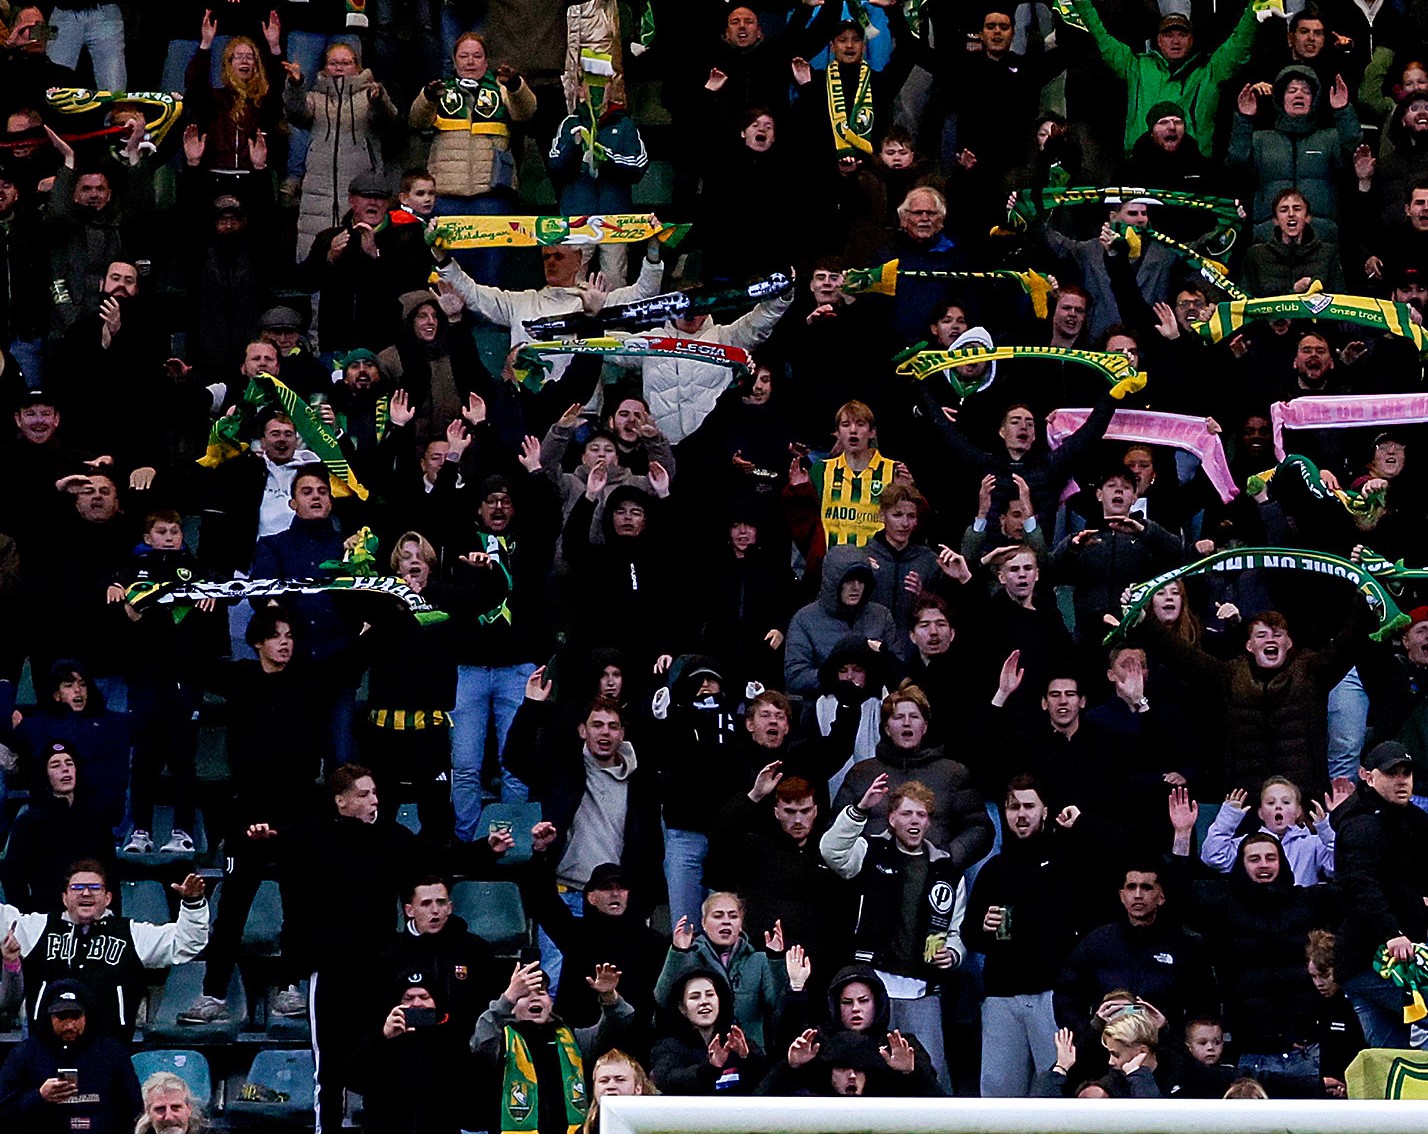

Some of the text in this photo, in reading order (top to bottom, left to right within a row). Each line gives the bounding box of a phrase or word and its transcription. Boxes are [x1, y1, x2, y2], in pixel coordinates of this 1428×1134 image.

[1275, 299, 1299, 314] club
[1329, 307, 1357, 318] onze
[676, 342, 727, 358] LEGIA
[826, 506, 881, 525] #ADOgroe
